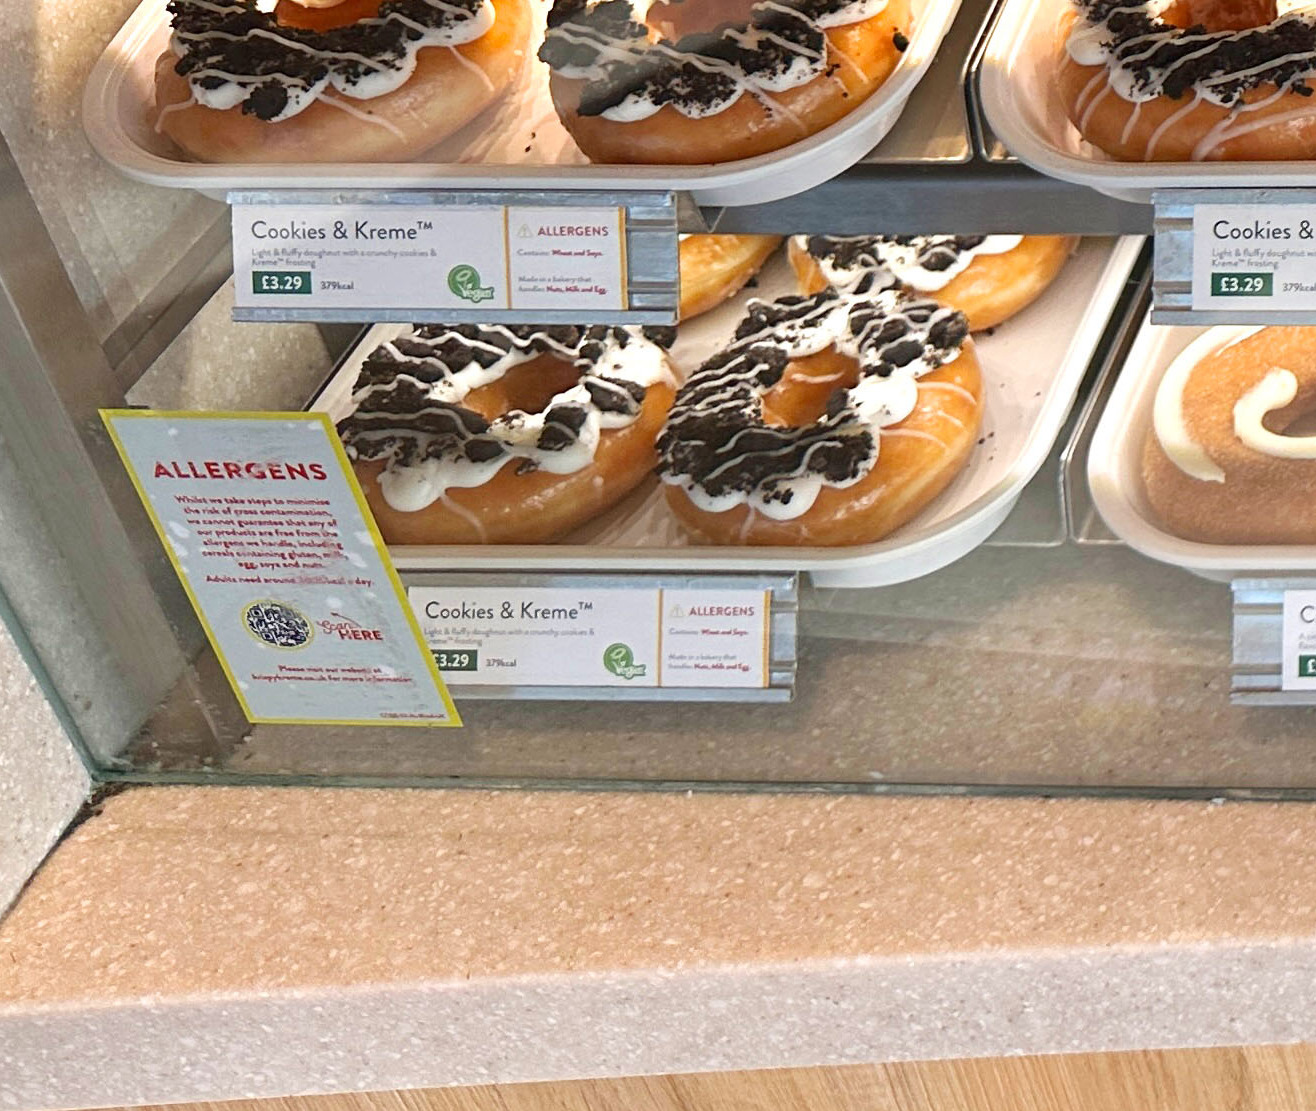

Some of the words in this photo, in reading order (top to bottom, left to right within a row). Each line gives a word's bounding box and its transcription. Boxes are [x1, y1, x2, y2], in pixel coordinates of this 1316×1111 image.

[251, 220, 326, 240] Cookies
[333, 221, 348, 239] &
[537, 226, 609, 237] ALLERGENS
[1213, 220, 1291, 240] Cookies
[1299, 220, 1314, 239] &
[261, 275, 302, 290] £3.29
[1220, 277, 1264, 292] £3.29
[154, 461, 328, 481] ALLERGENS
[425, 600, 494, 620] Cookies
[500, 601, 514, 619] &
[688, 605, 755, 618] ALLERGENS
[338, 629, 383, 641] HERE
